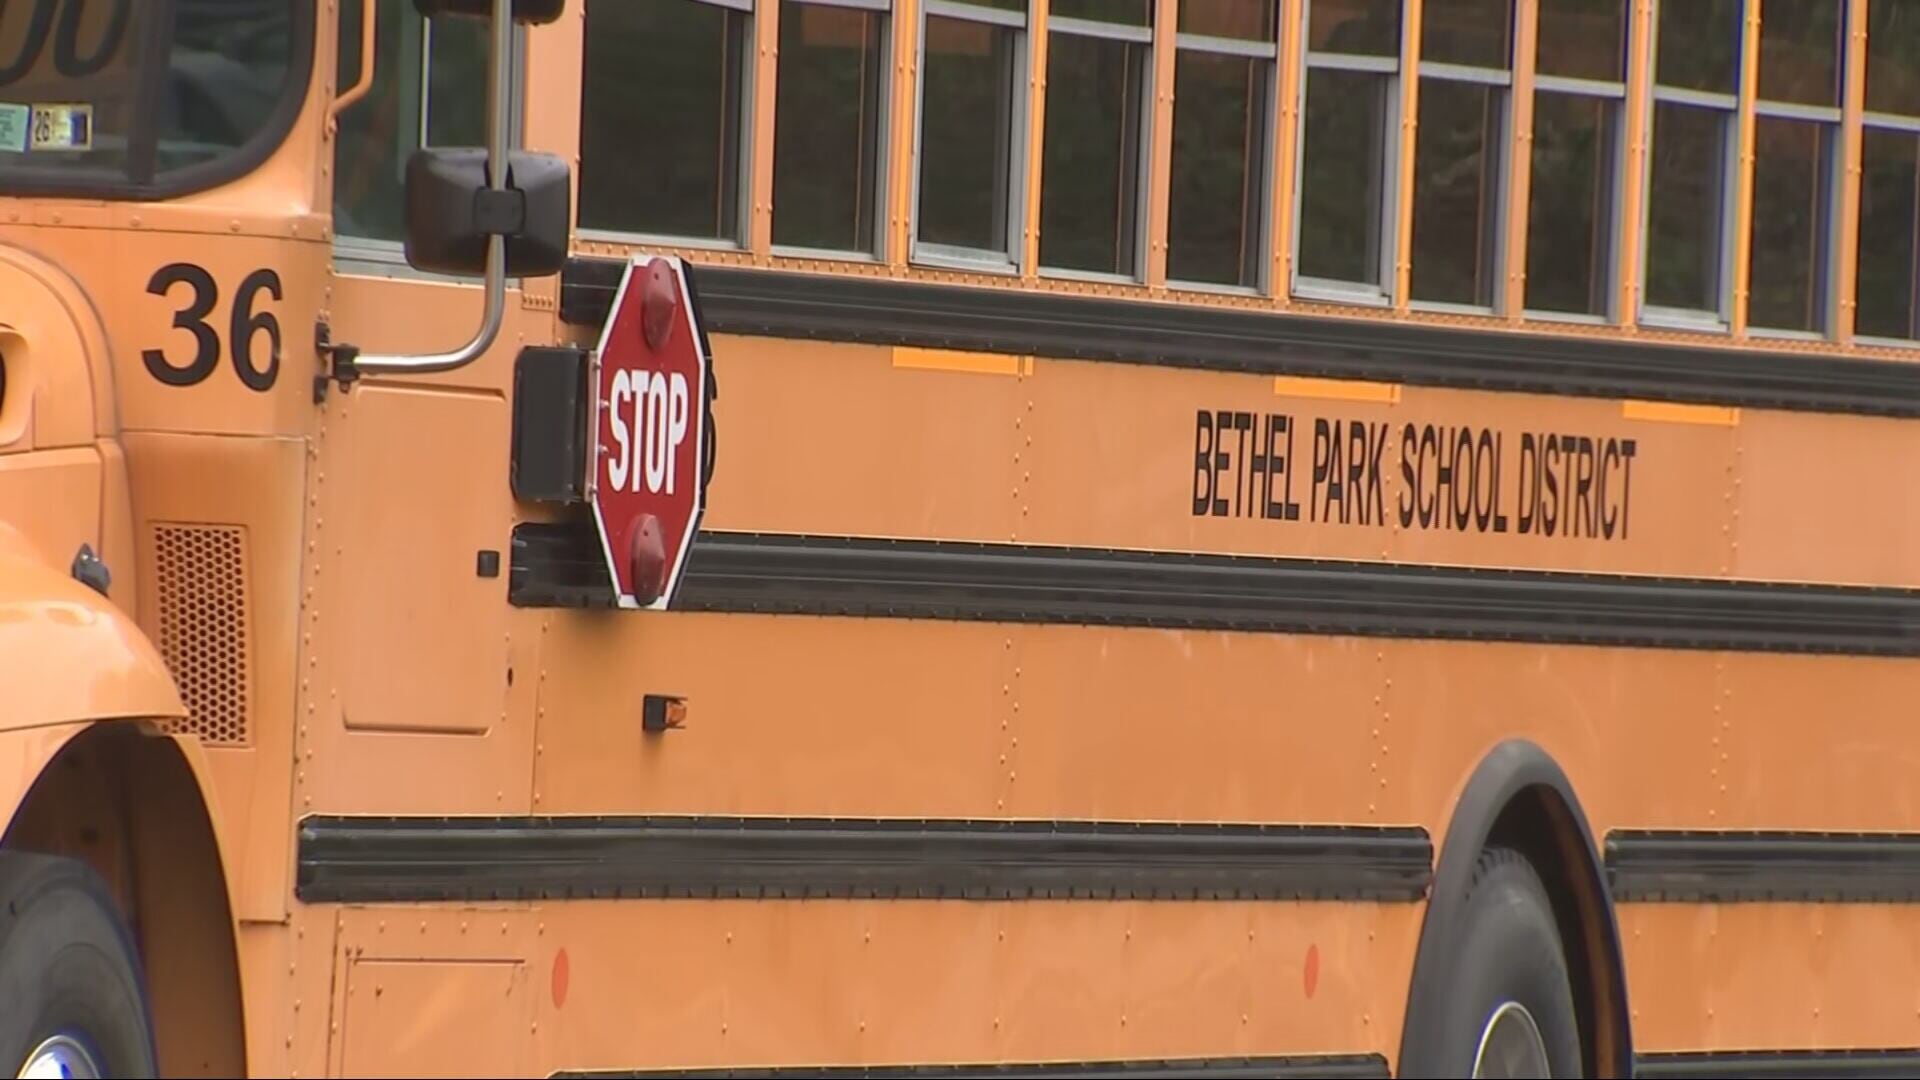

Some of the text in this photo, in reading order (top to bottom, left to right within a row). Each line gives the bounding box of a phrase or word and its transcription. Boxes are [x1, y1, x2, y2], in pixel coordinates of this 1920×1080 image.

[141, 262, 283, 392] 36
[608, 368, 689, 495] STOP
[1192, 409, 1637, 540] BETHEL PARK SCHOOL DISTRICT
